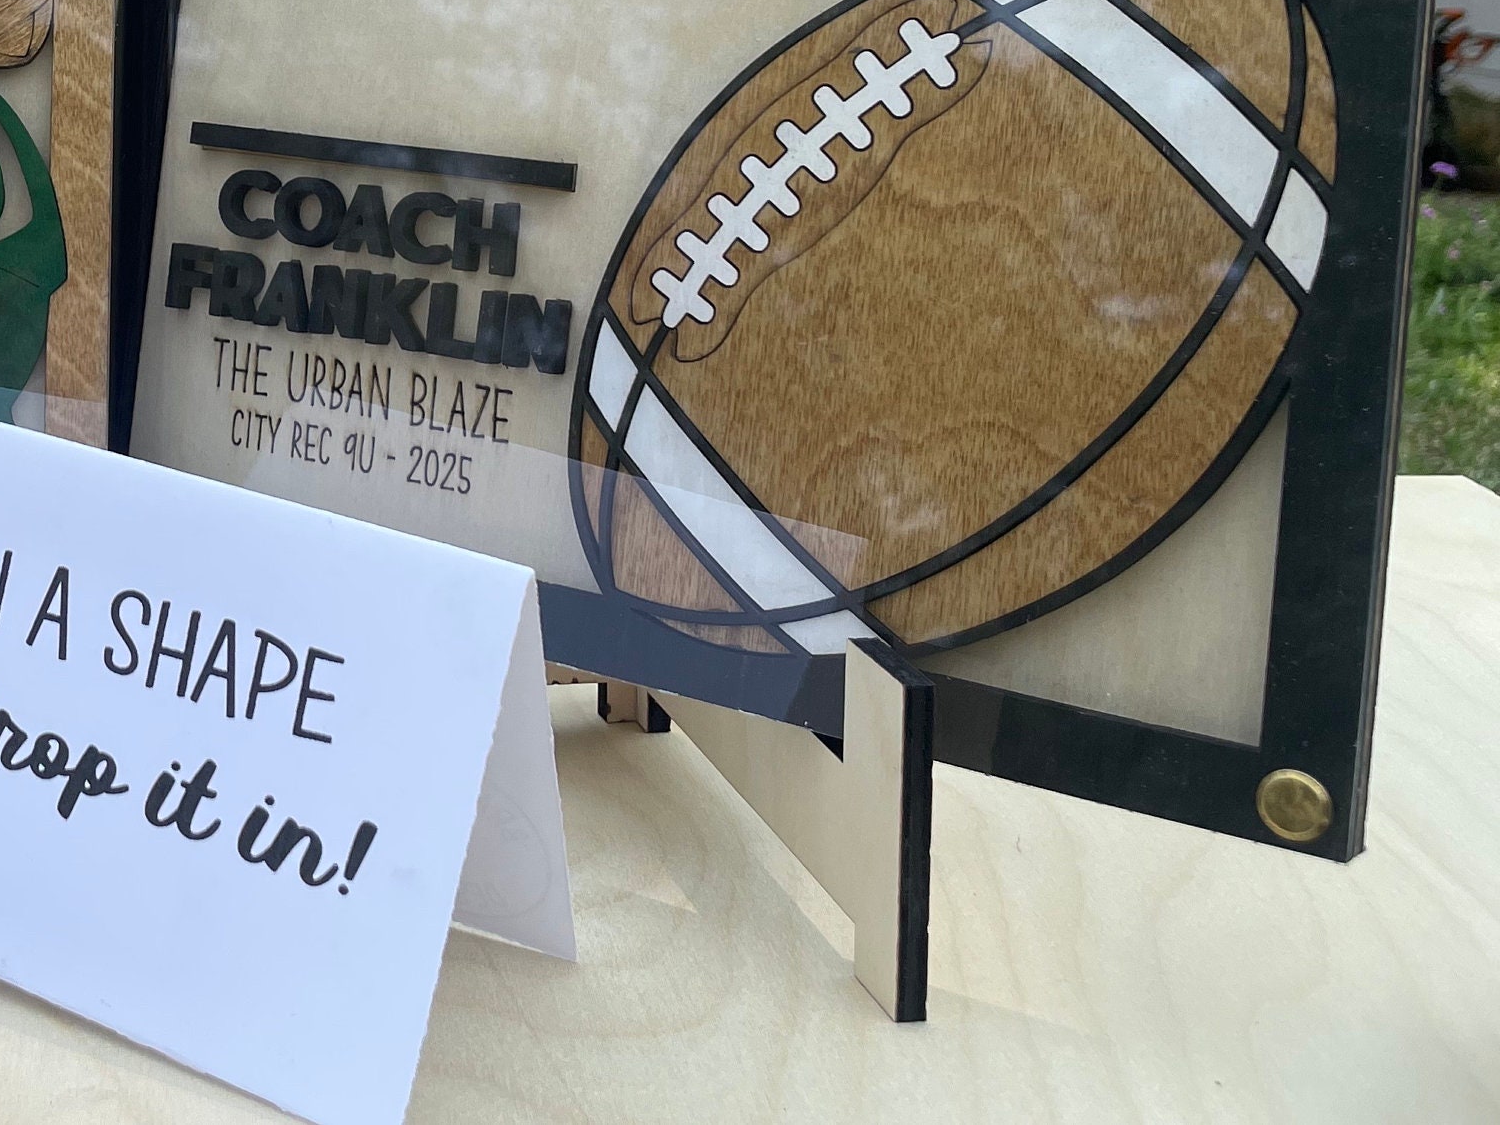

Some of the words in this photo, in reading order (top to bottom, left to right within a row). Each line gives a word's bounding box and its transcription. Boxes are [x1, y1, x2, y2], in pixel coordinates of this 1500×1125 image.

[217, 169, 522, 277] COACH
[164, 242, 573, 375] FRANKLIN
[213, 337, 273, 397] THE
[287, 350, 391, 421] URBAN
[409, 371, 514, 444] BLAZE
[231, 408, 283, 454] CITY
[290, 421, 333, 465] REC
[343, 431, 376, 474] 9U
[406, 445, 473, 495] 2025
[25, 564, 70, 662] A
[103, 588, 346, 745] SHAPE
[144, 757, 222, 840] it
[236, 794, 379, 897] in!
